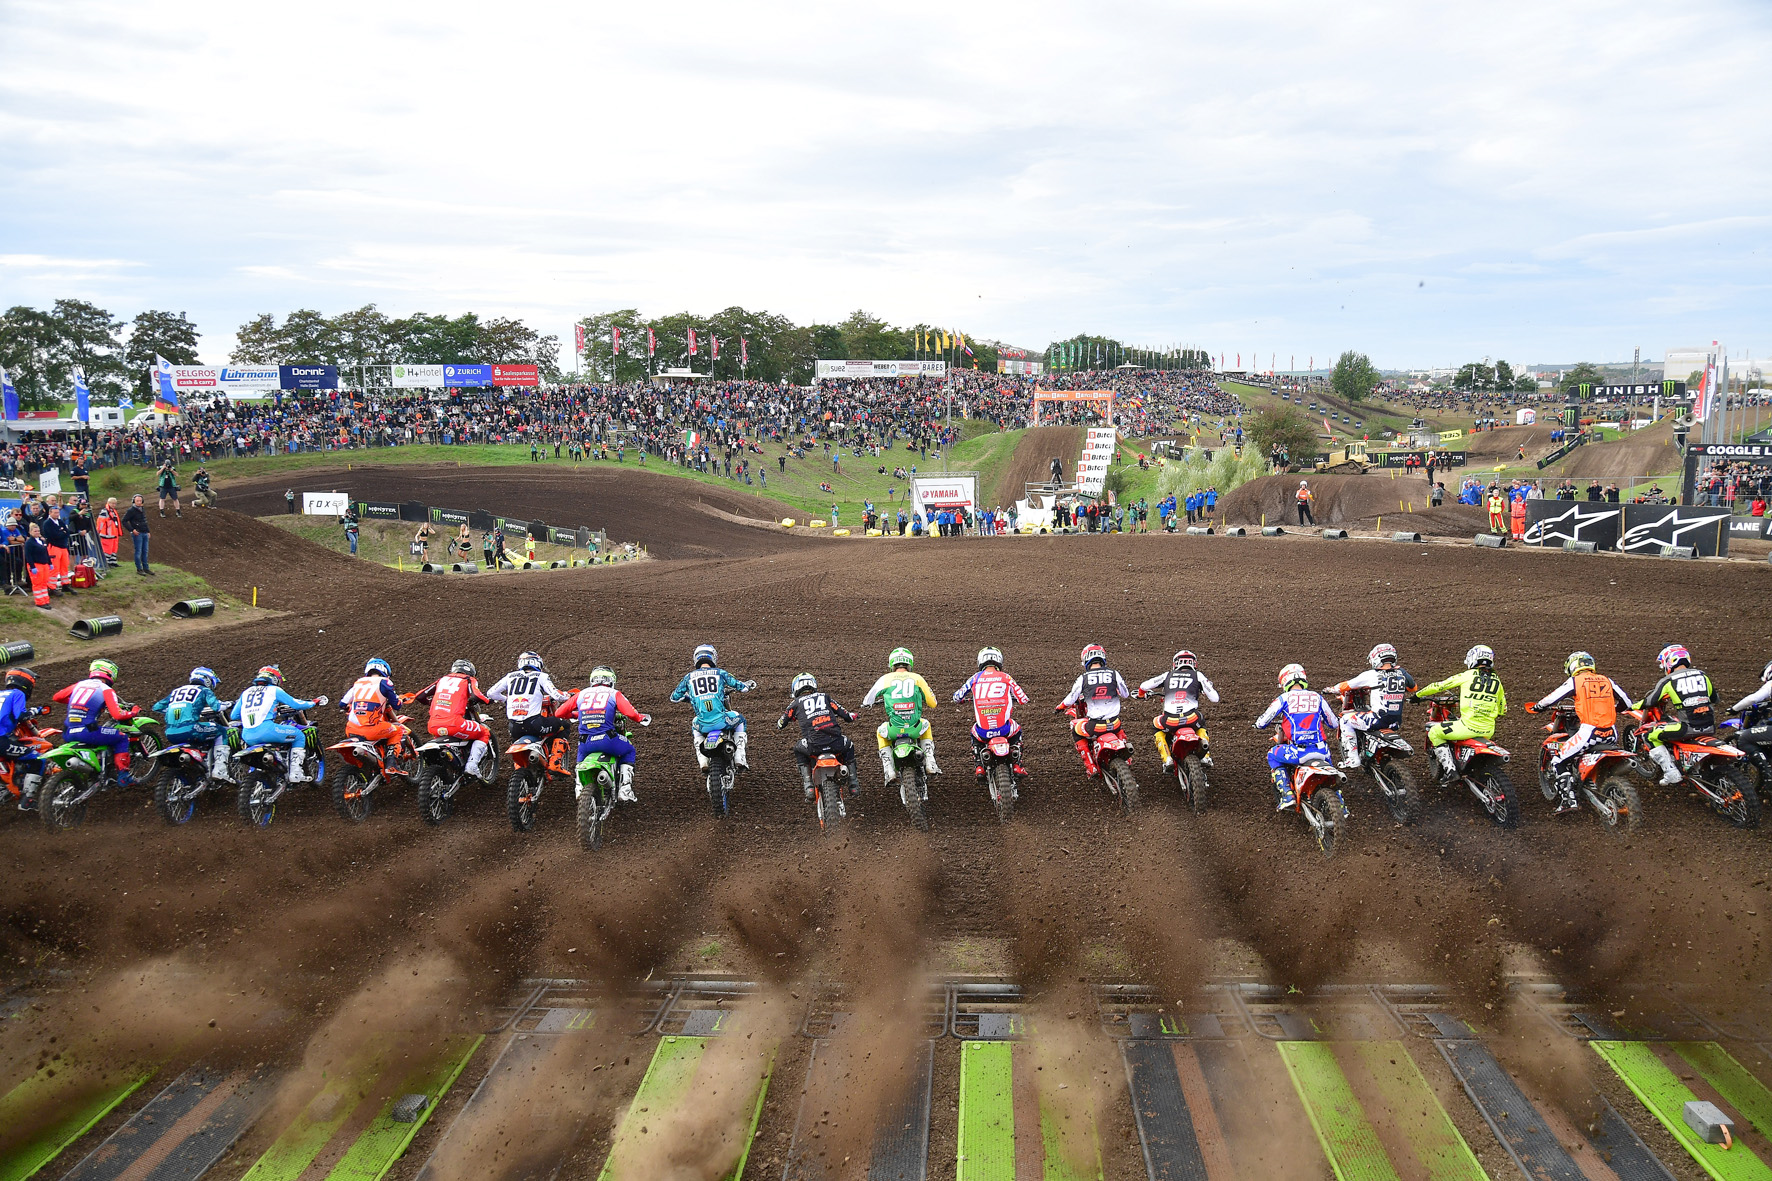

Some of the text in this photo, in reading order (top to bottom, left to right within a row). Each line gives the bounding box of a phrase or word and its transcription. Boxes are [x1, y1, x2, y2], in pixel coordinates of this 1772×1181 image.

[922, 364, 943, 372] BARES
[1595, 385, 1659, 395] FINISH
[1706, 446, 1760, 455] GOGGLE
[930, 490, 958, 498] YAMAHA
[1730, 522, 1760, 531] LANE
[509, 677, 538, 696] 101
[692, 676, 718, 696] 198
[1088, 672, 1113, 685] 516
[1169, 678, 1194, 689] 517
[1470, 676, 1500, 695] 80
[1676, 675, 1707, 695] 403
[71, 687, 96, 706] 11
[890, 678, 915, 699] 20
[975, 682, 1007, 700] 118
[1582, 681, 1612, 699] 192
[245, 691, 264, 708] 93
[580, 691, 610, 711] 39
[803, 696, 826, 715] 94
[1288, 695, 1320, 714] 253
